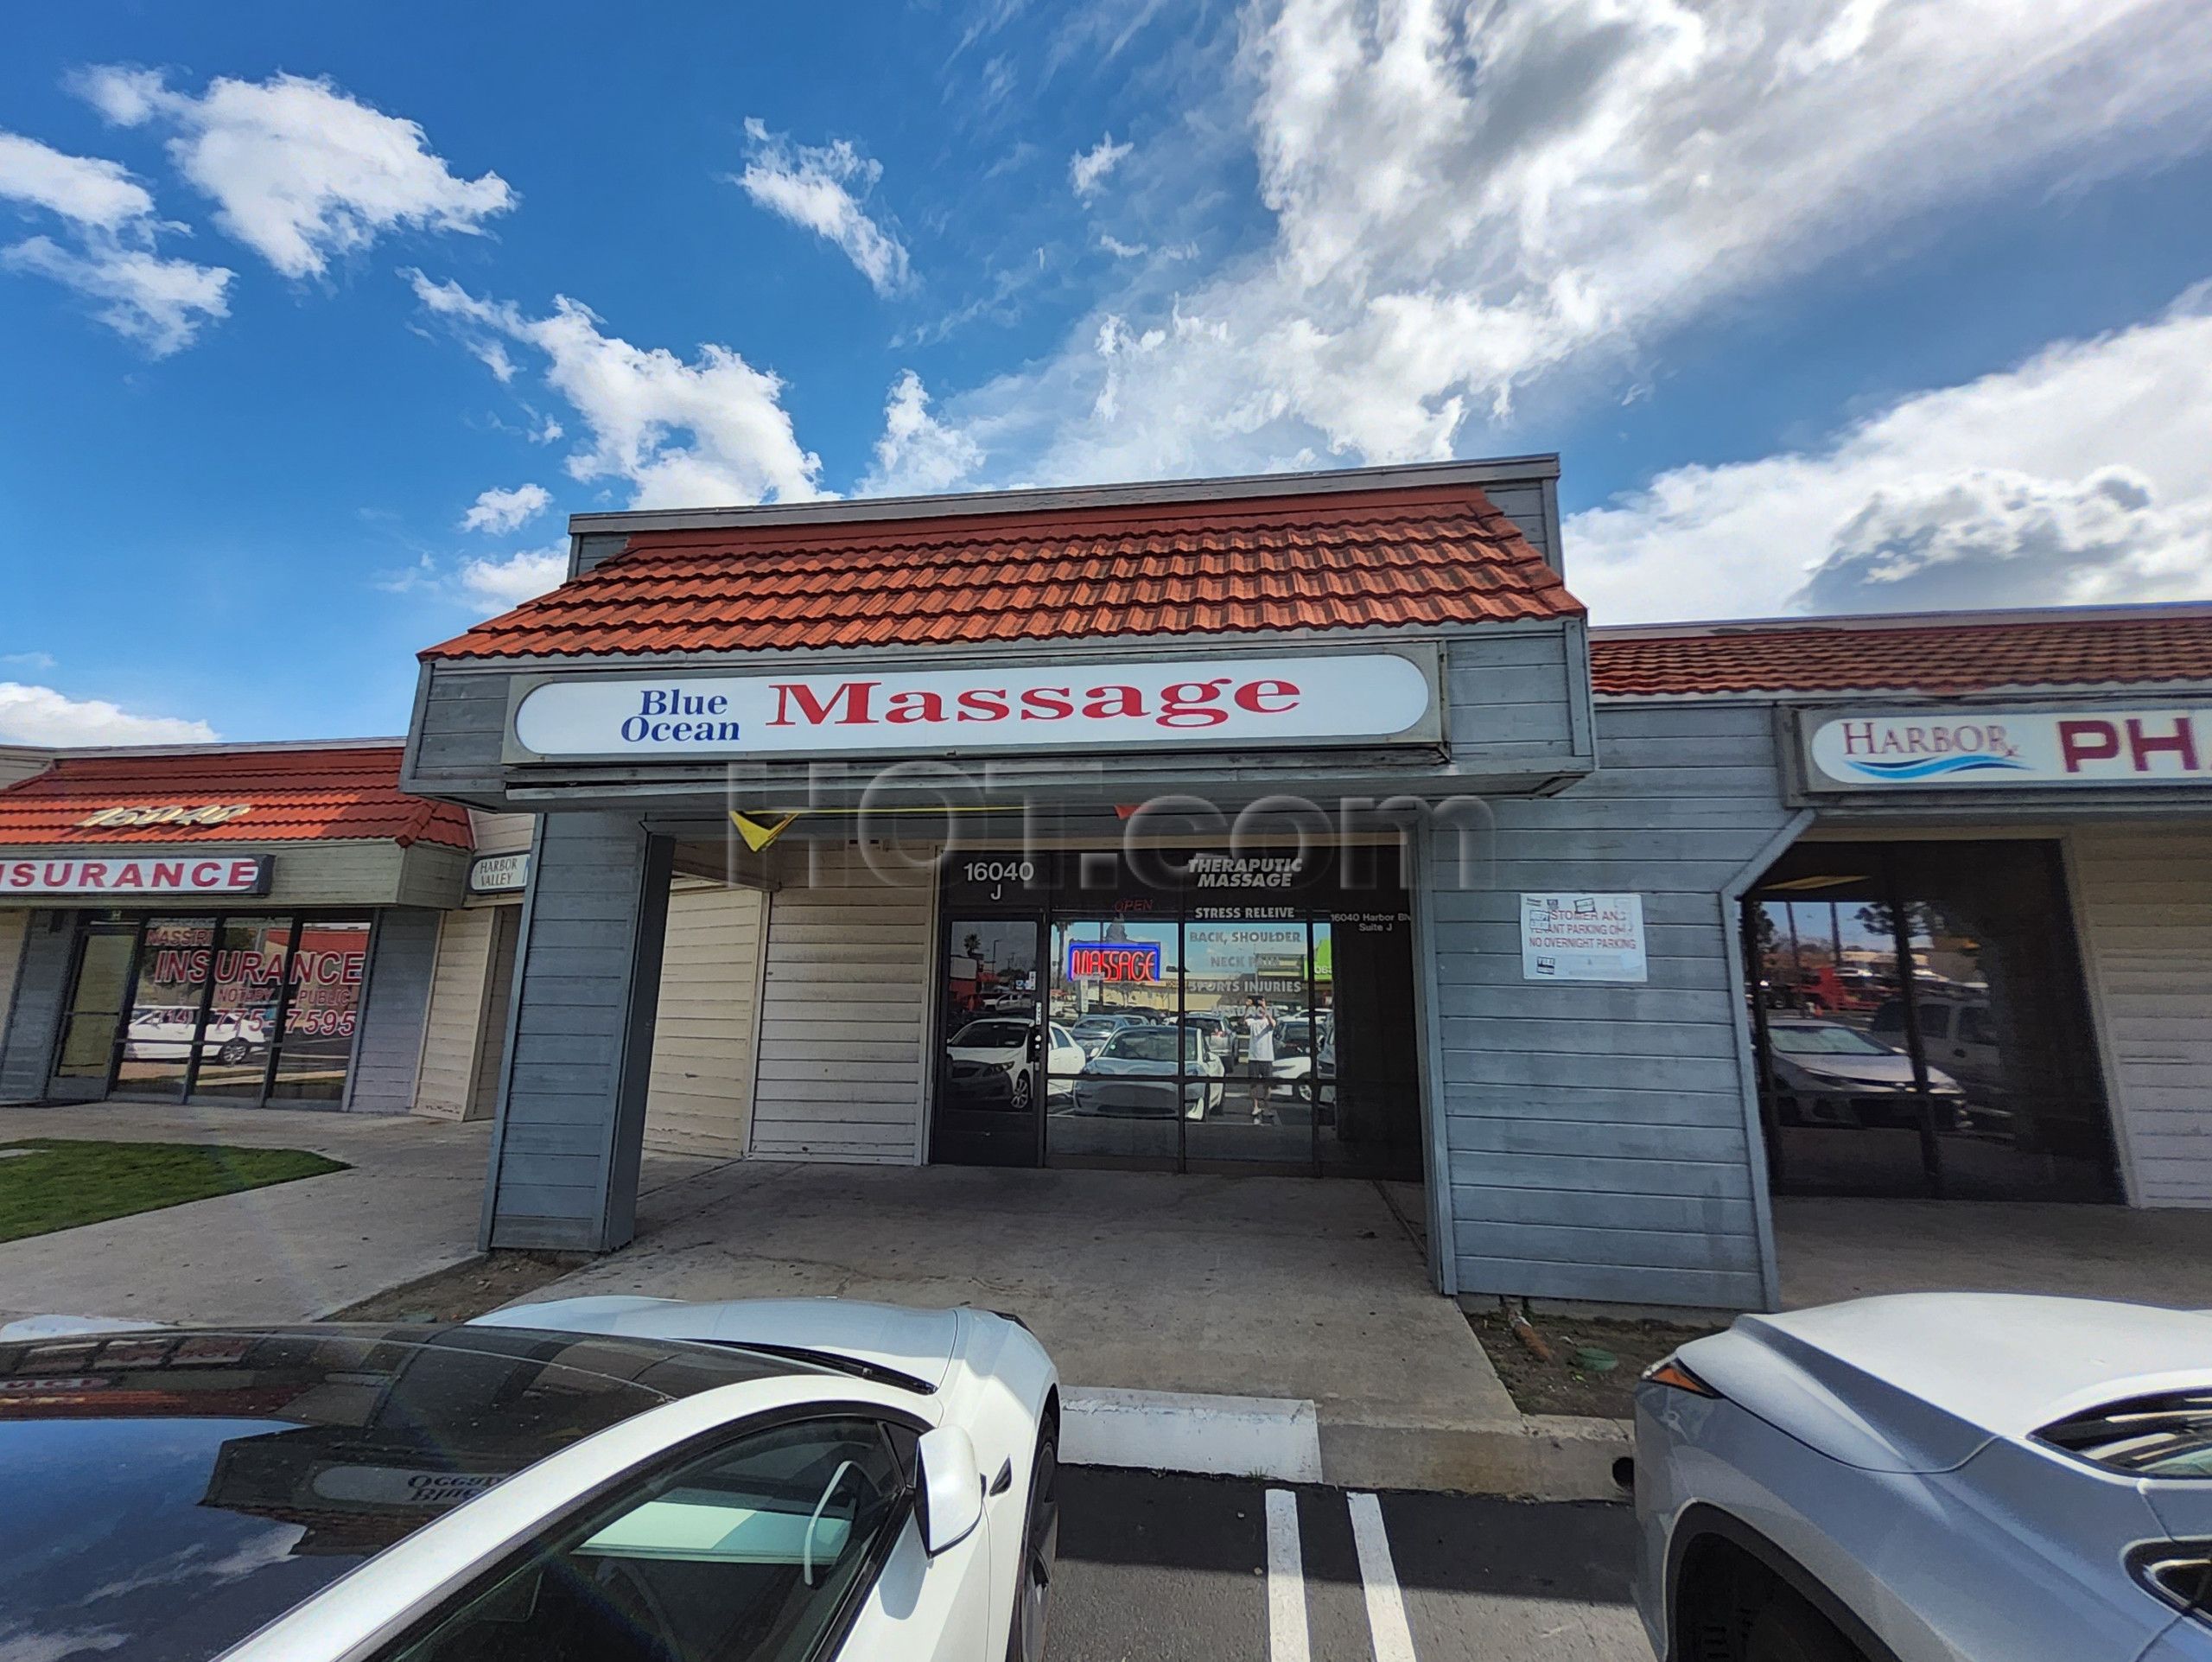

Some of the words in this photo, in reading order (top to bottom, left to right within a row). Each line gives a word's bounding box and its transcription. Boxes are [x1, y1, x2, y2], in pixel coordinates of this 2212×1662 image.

[639, 689, 728, 716] Blue
[766, 678, 1301, 728] Massage
[620, 715, 741, 742] Ocean
[2056, 717, 2212, 774] PH
[480, 857, 518, 874] HARBOR
[963, 862, 1034, 881] 16040
[1187, 857, 1303, 873] THERAPUTIC
[0, 861, 257, 888] SURANCE
[1197, 873, 1293, 888] MASSAGE
[990, 883, 1001, 900] J
[1114, 900, 1153, 912] OPEN
[1195, 907, 1242, 919] STRESS
[1244, 907, 1295, 919] RELEIVE
[1358, 923, 1383, 932] Suite
[1231, 932, 1300, 943] SHOULDER
[1529, 938, 1542, 947] NO
[154, 950, 365, 986] INSURANCE
[1072, 950, 1156, 981] MASSAGE
[1211, 956, 1245, 967] NECK
[1188, 980, 1241, 992] SPORTS
[1244, 980, 1302, 992] INJURIES
[296, 989, 351, 1006] PUBLIC
